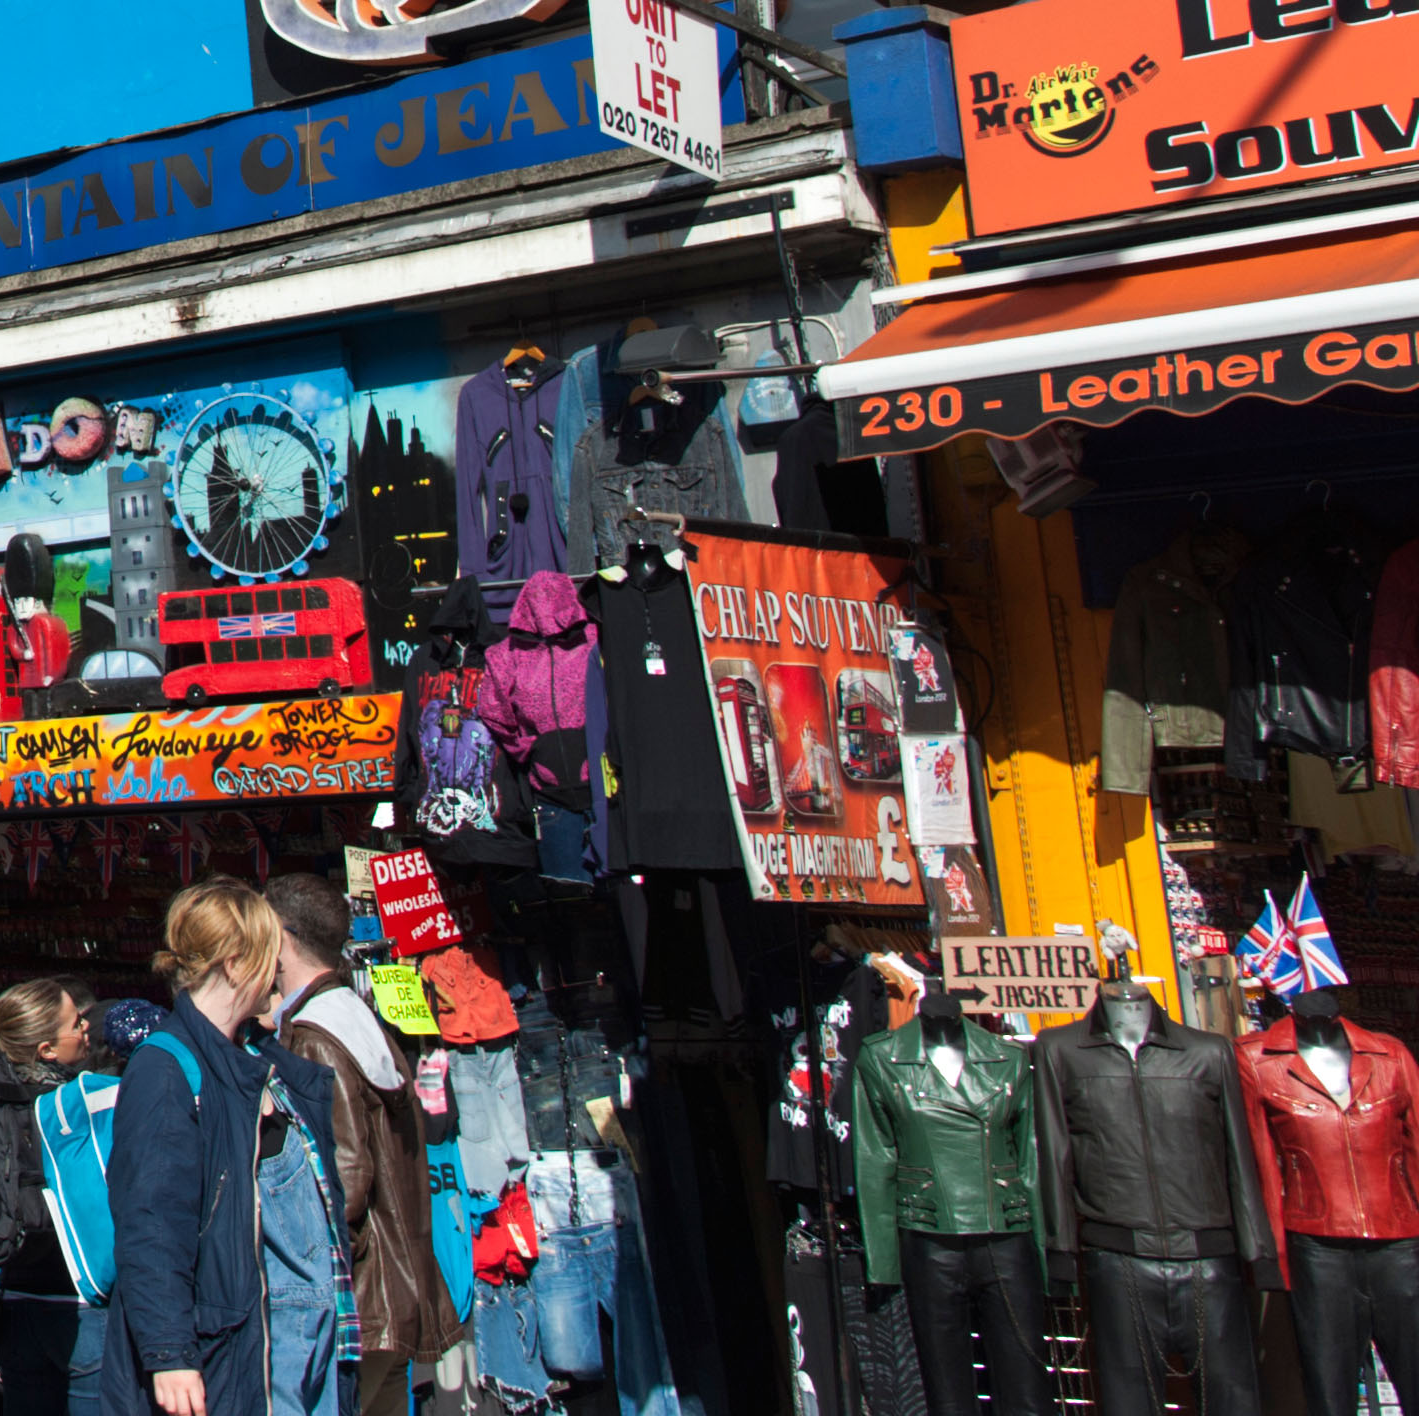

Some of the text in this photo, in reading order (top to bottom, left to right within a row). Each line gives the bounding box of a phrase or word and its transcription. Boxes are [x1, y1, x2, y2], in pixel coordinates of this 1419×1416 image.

[646, 36, 666, 68] TO
[635, 62, 681, 124] LET
[973, 54, 1160, 140] Martens
[240, 114, 351, 196] OF
[374, 54, 598, 168] JEA
[603, 102, 721, 174] 020 7267 4461
[860, 385, 963, 437] 230
[1039, 348, 1283, 414] Leather
[1303, 322, 1419, 376] Ga
[695, 582, 905, 656] CHEAP SOUVENIR
[269, 697, 378, 732] TOWER
[16, 722, 104, 769] CAMDEN
[311, 752, 396, 792] STREE
[790, 834, 849, 877] MAGNETS
[876, 795, 912, 885] £
[373, 851, 434, 885] DIESEL
[410, 915, 436, 941] FROM
[953, 944, 1097, 979] LEATHER
[396, 986, 414, 1001] DE
[991, 983, 1090, 1010] JACKET
